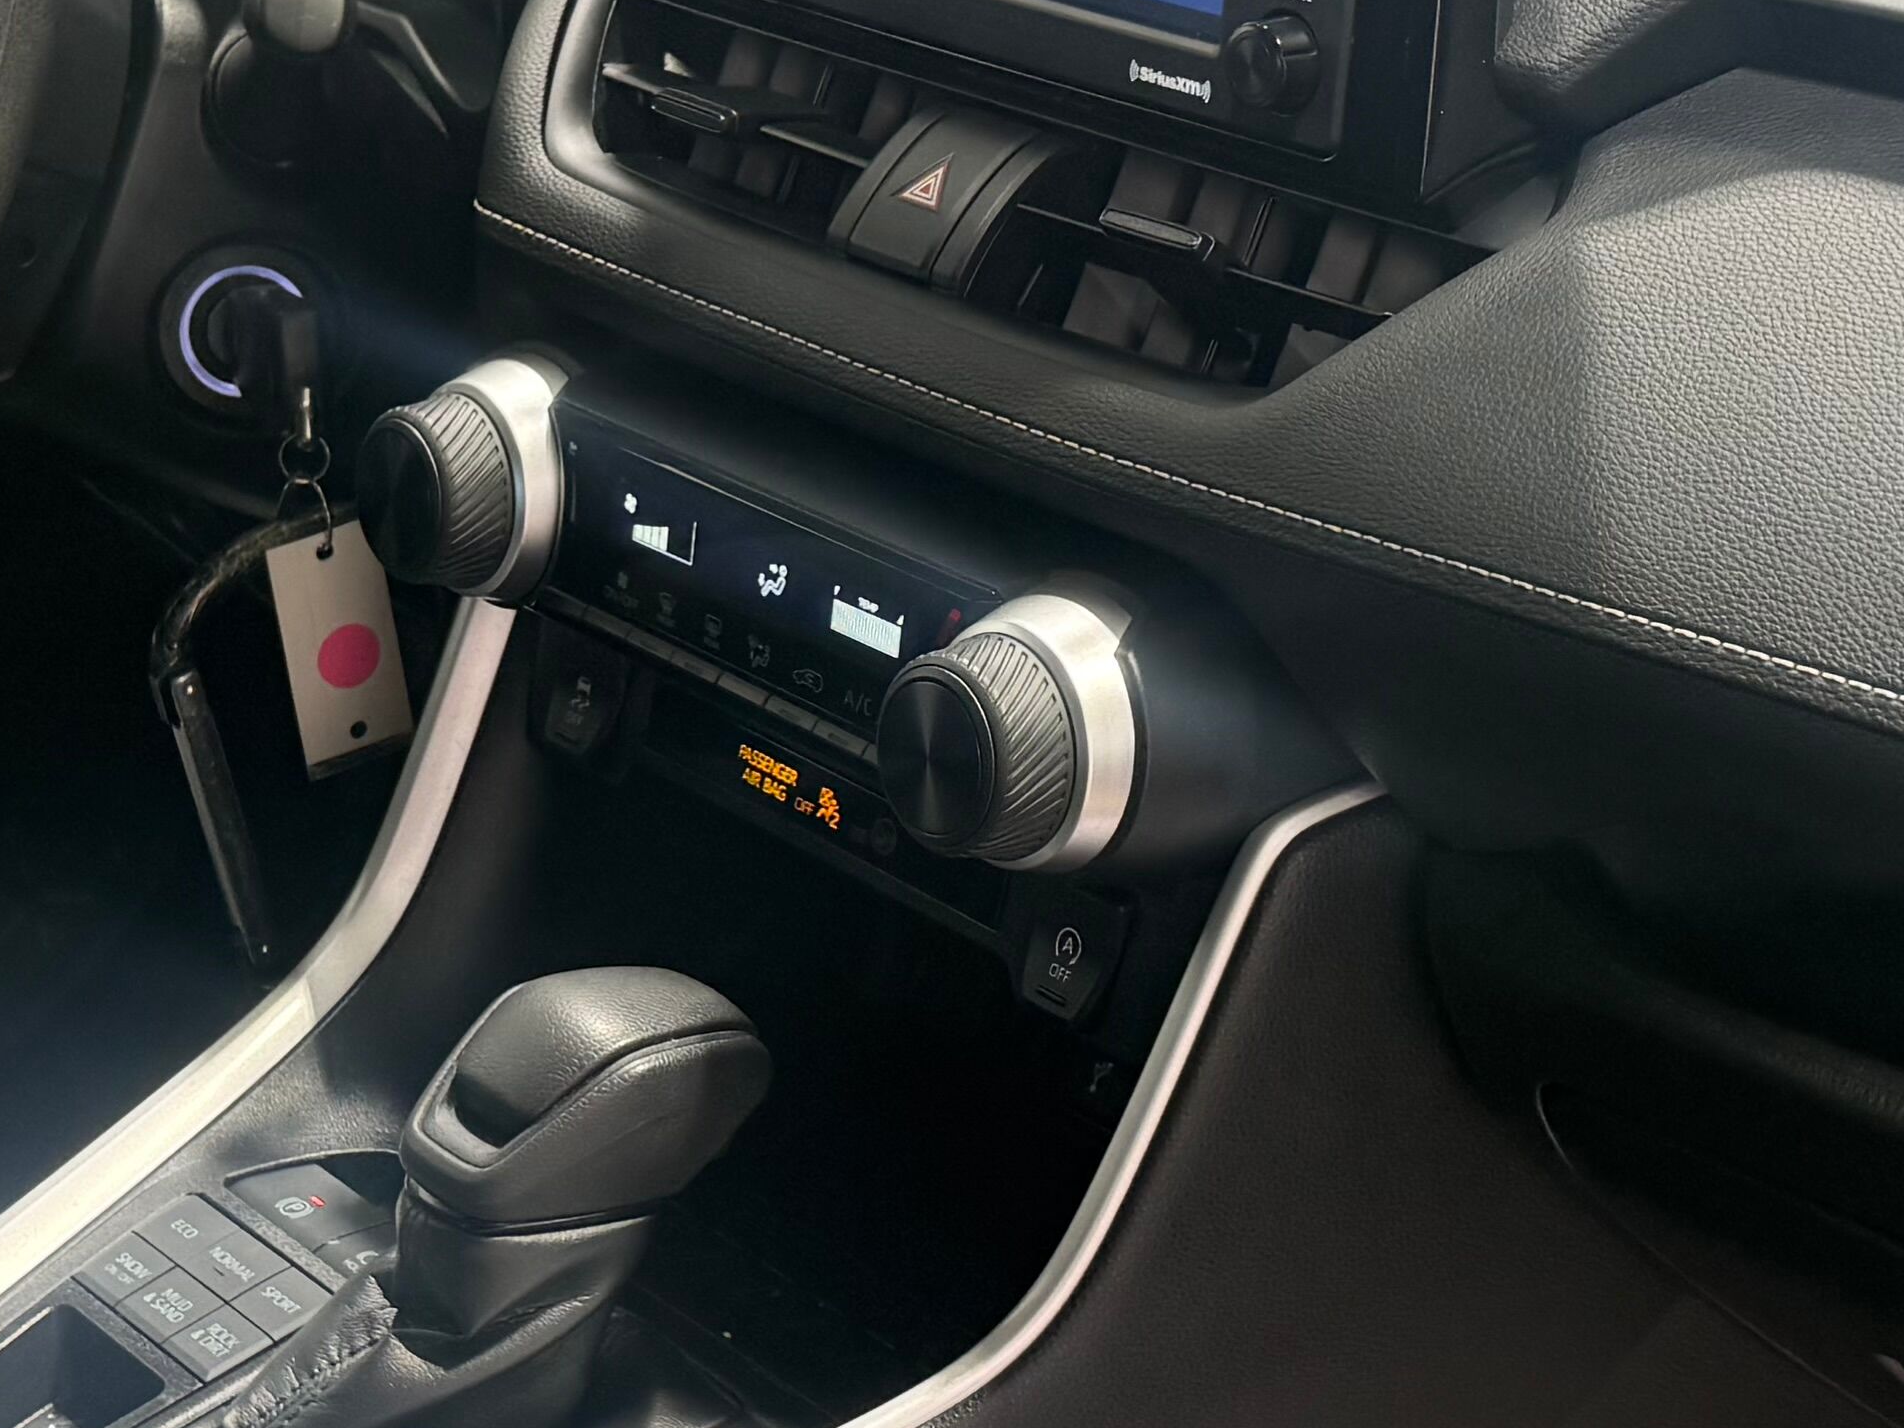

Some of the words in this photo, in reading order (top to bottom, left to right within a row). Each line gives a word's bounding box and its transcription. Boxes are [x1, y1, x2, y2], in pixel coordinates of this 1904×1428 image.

[844, 689, 873, 717] A/C
[738, 743, 798, 787] PASSENGER
[742, 767, 762, 788] AIR
[762, 776, 788, 802] BAG
[794, 796, 816, 815] OFF
[1048, 962, 1072, 983] OFF
[170, 1219, 199, 1239] ECO
[115, 1252, 153, 1278] SNOW
[209, 1246, 255, 1282] NORMAL
[150, 1297, 185, 1323] SAND
[161, 1288, 194, 1312] MUD
[261, 1286, 302, 1313] SPORT
[199, 1335, 231, 1357] DIRT
[206, 1323, 240, 1349] ROCK
